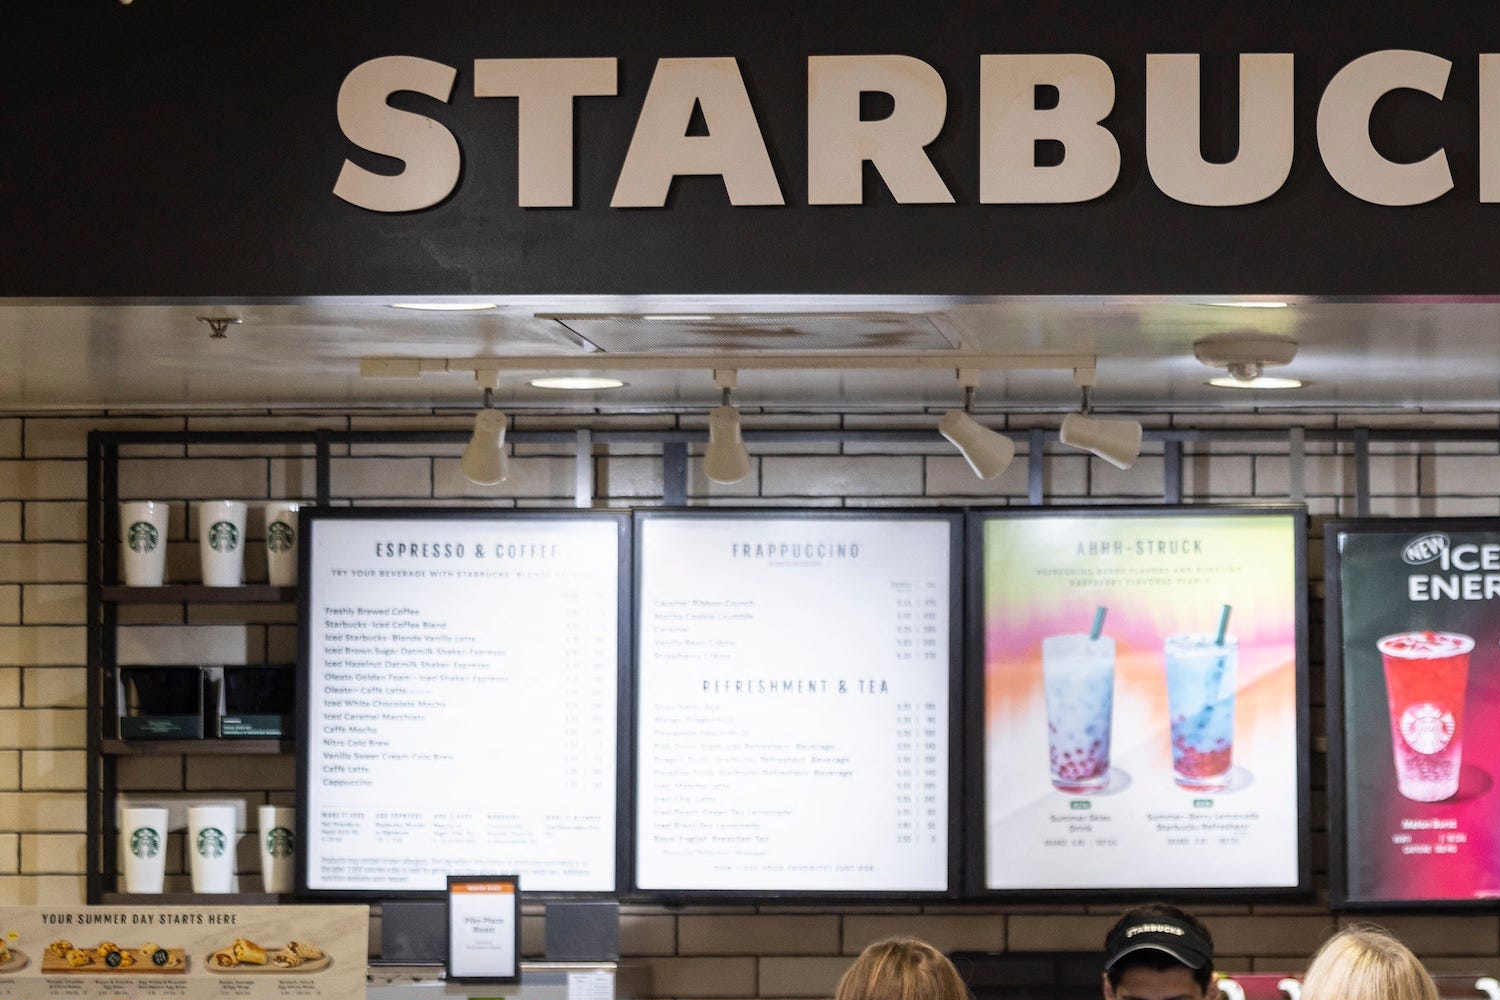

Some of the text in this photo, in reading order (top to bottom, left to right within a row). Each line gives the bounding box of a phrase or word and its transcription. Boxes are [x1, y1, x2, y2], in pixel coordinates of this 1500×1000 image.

[376, 543, 560, 559] ESPRESSO & COFFEE
[732, 544, 860, 558] FRAPPUCCINO
[1077, 540, 1203, 555] AHHH-STRUCK
[1406, 535, 1447, 562] NEW
[703, 679, 889, 694] REFRESHMENT & TEA
[42, 914, 238, 925] YOUR SUMMER DAY STARTS HERE
[1126, 923, 1184, 938] STARBUCKS
